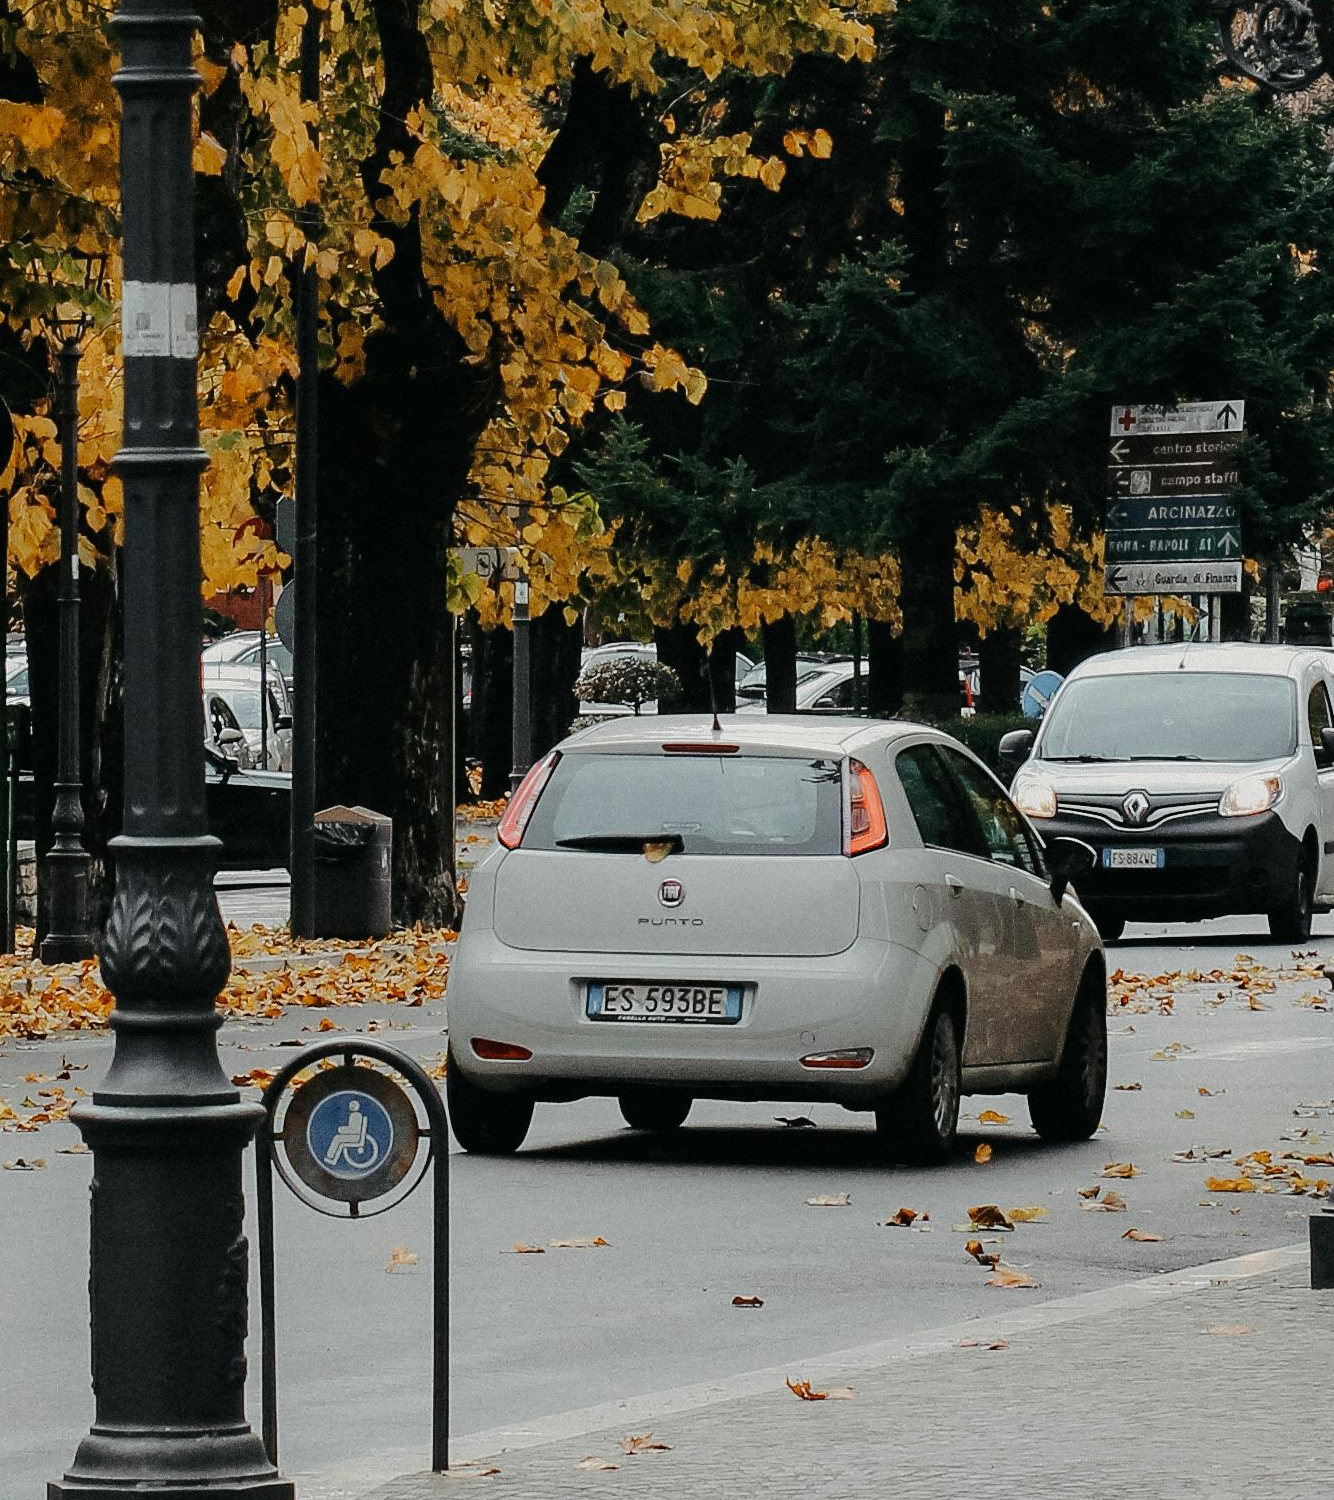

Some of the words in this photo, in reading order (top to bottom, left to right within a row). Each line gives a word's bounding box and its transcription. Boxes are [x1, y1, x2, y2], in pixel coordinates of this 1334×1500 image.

[1153, 443, 1192, 455] centro
[1161, 475, 1201, 487] campo
[1147, 505, 1237, 520] ARCINAZZO
[1149, 538, 1189, 552] NAPOLI
[1155, 572, 1188, 585] Guardia
[1193, 572, 1201, 584] di
[1205, 572, 1238, 584] Finanza
[637, 917, 705, 926] PUNTO
[603, 986, 635, 1012] ES
[645, 986, 724, 1015] 593BE
